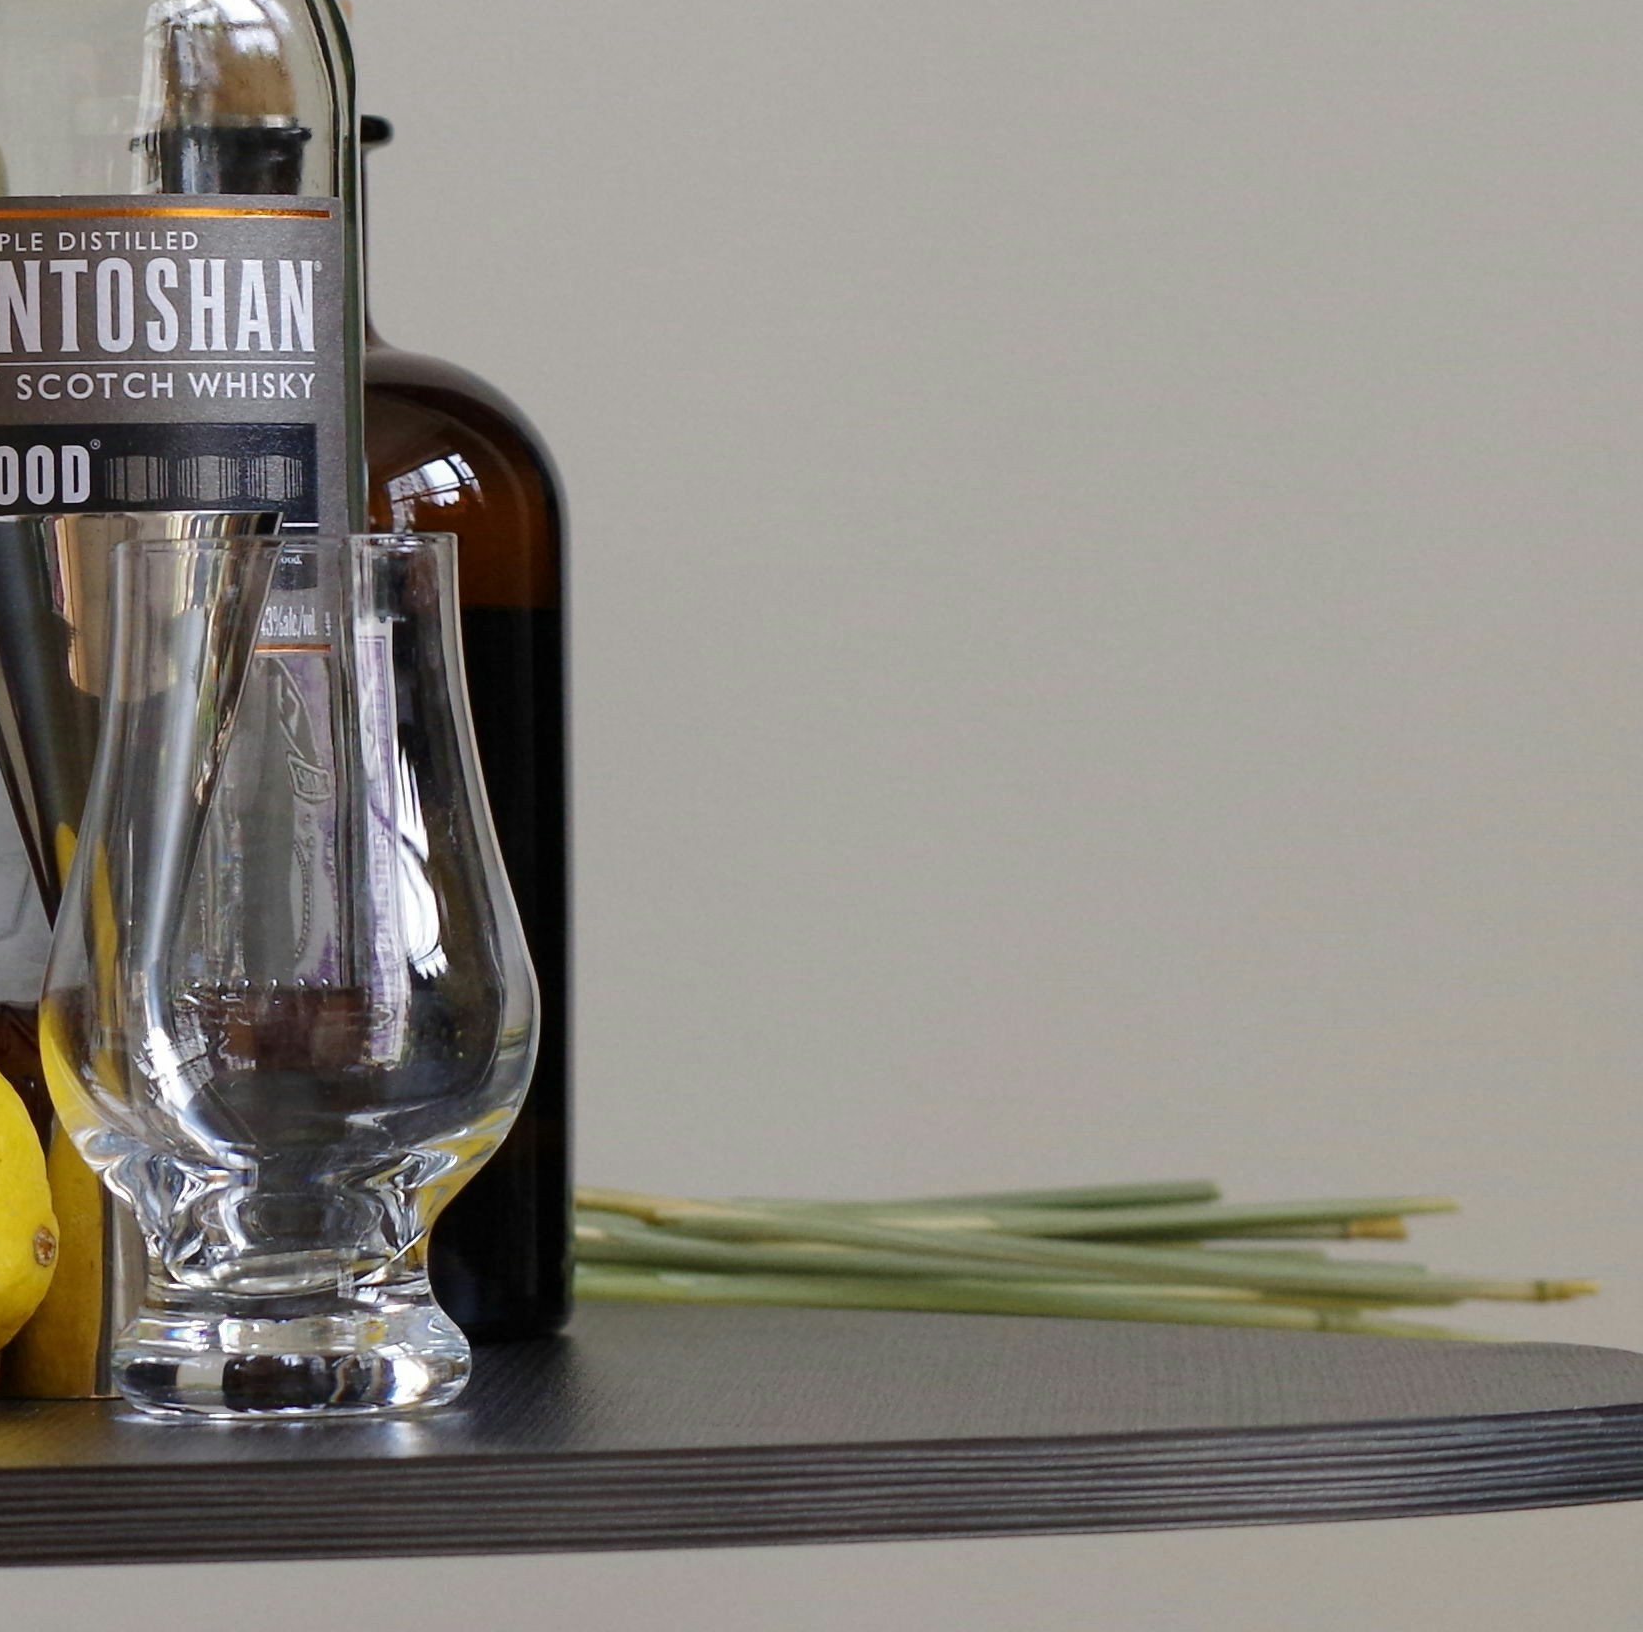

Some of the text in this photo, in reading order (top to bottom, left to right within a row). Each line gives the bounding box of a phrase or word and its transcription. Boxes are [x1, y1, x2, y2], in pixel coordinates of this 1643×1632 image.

[57, 230, 199, 253] DISTILLED
[16, 372, 174, 401] SCOTCH
[187, 372, 316, 400] WHISKY
